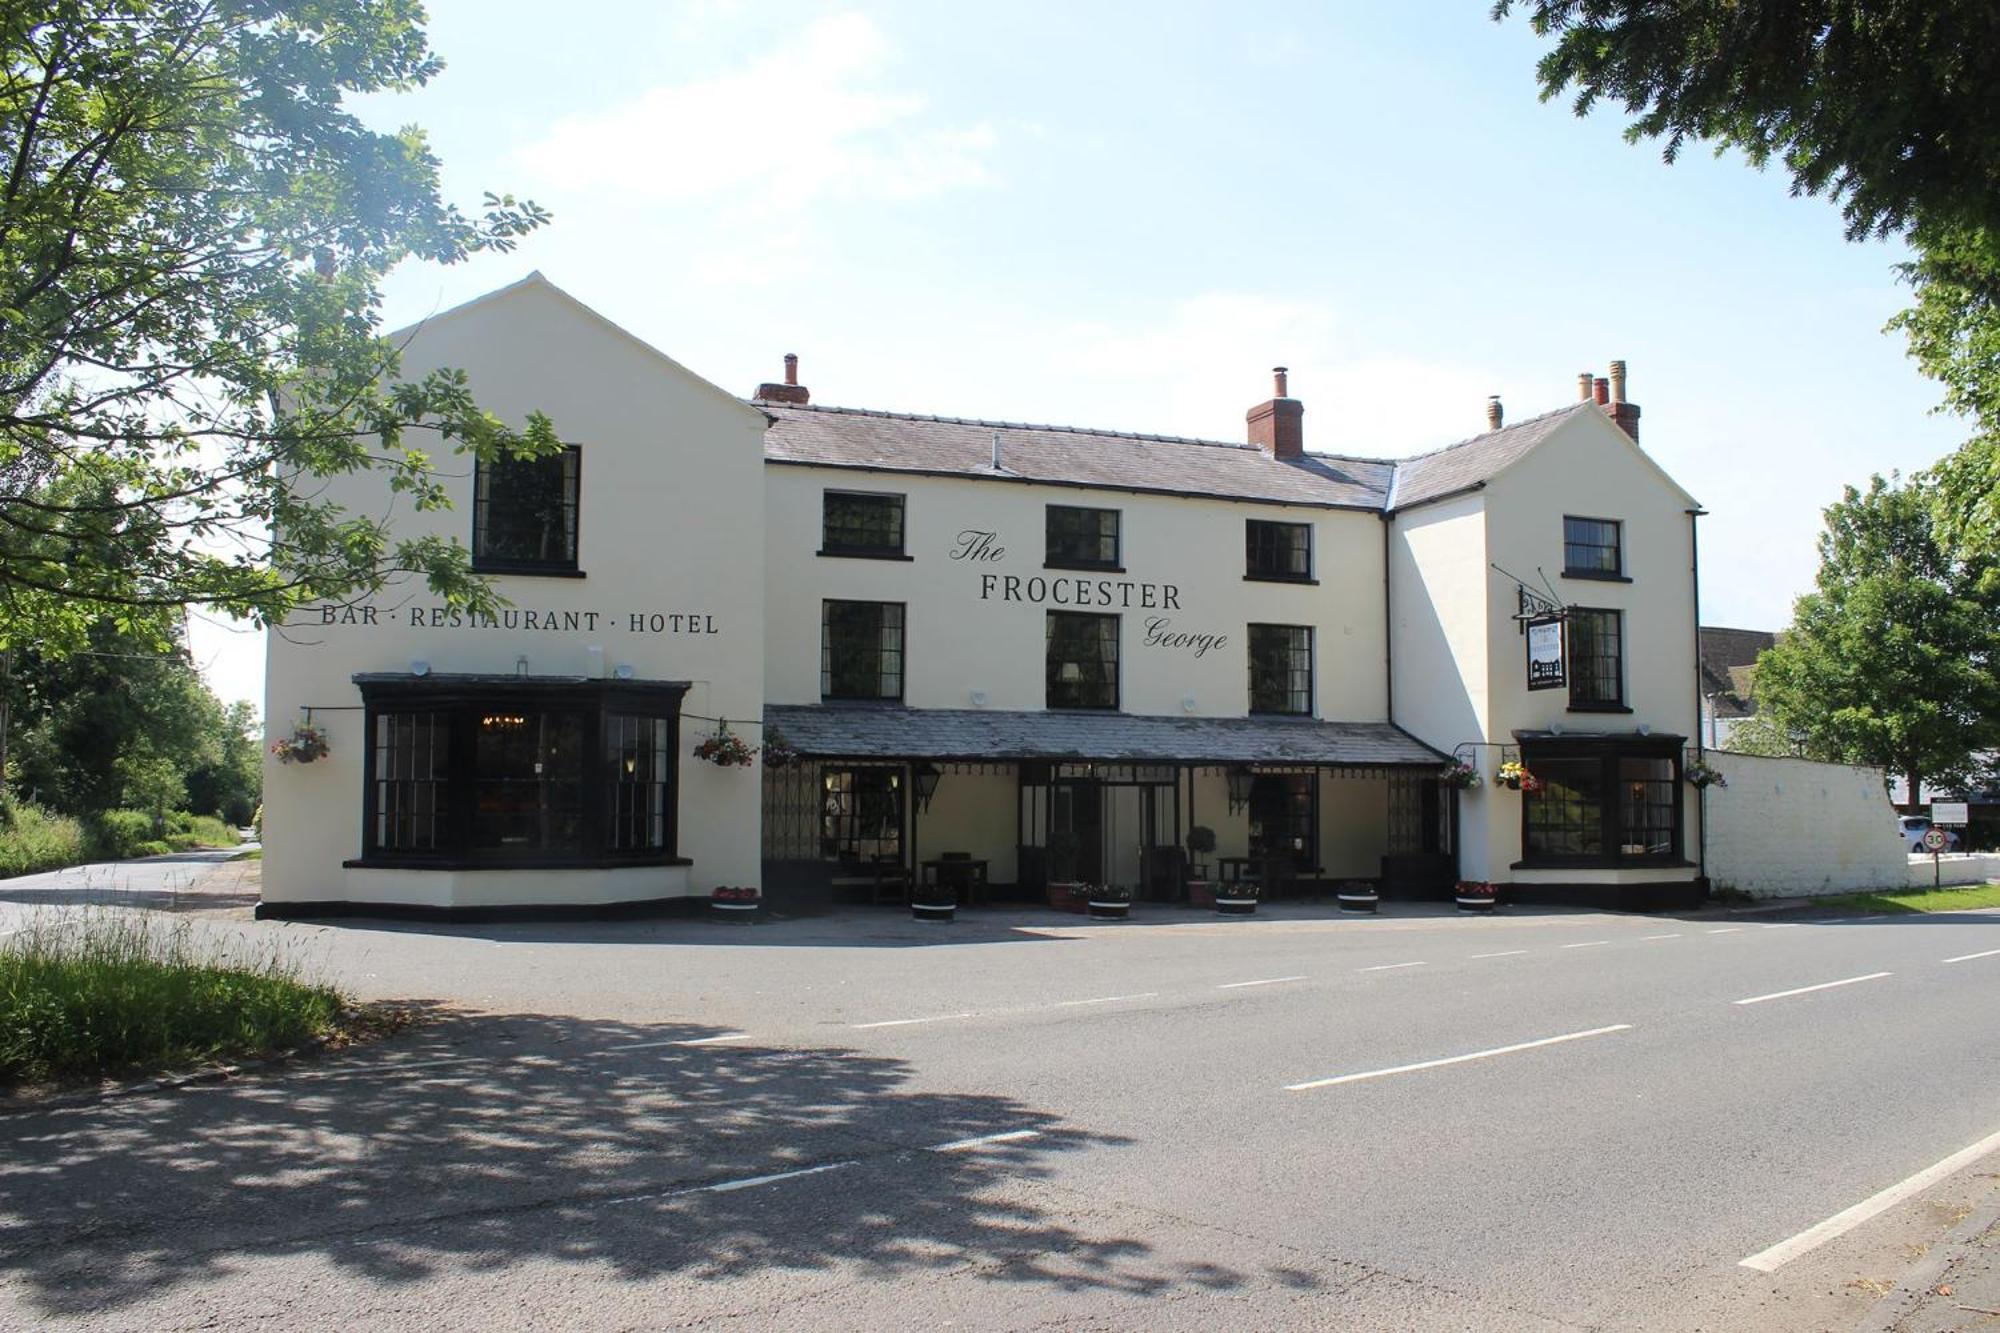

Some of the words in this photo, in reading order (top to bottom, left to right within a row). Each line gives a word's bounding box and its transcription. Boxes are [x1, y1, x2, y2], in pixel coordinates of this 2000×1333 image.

[949, 529, 1006, 562] The
[980, 574, 1181, 610] FROCESTER
[322, 604, 378, 626] BAR
[410, 607, 600, 632] RESTAURANT
[630, 613, 719, 635] HOTEL
[1143, 616, 1227, 658] George
[1927, 835, 1943, 844] 30
